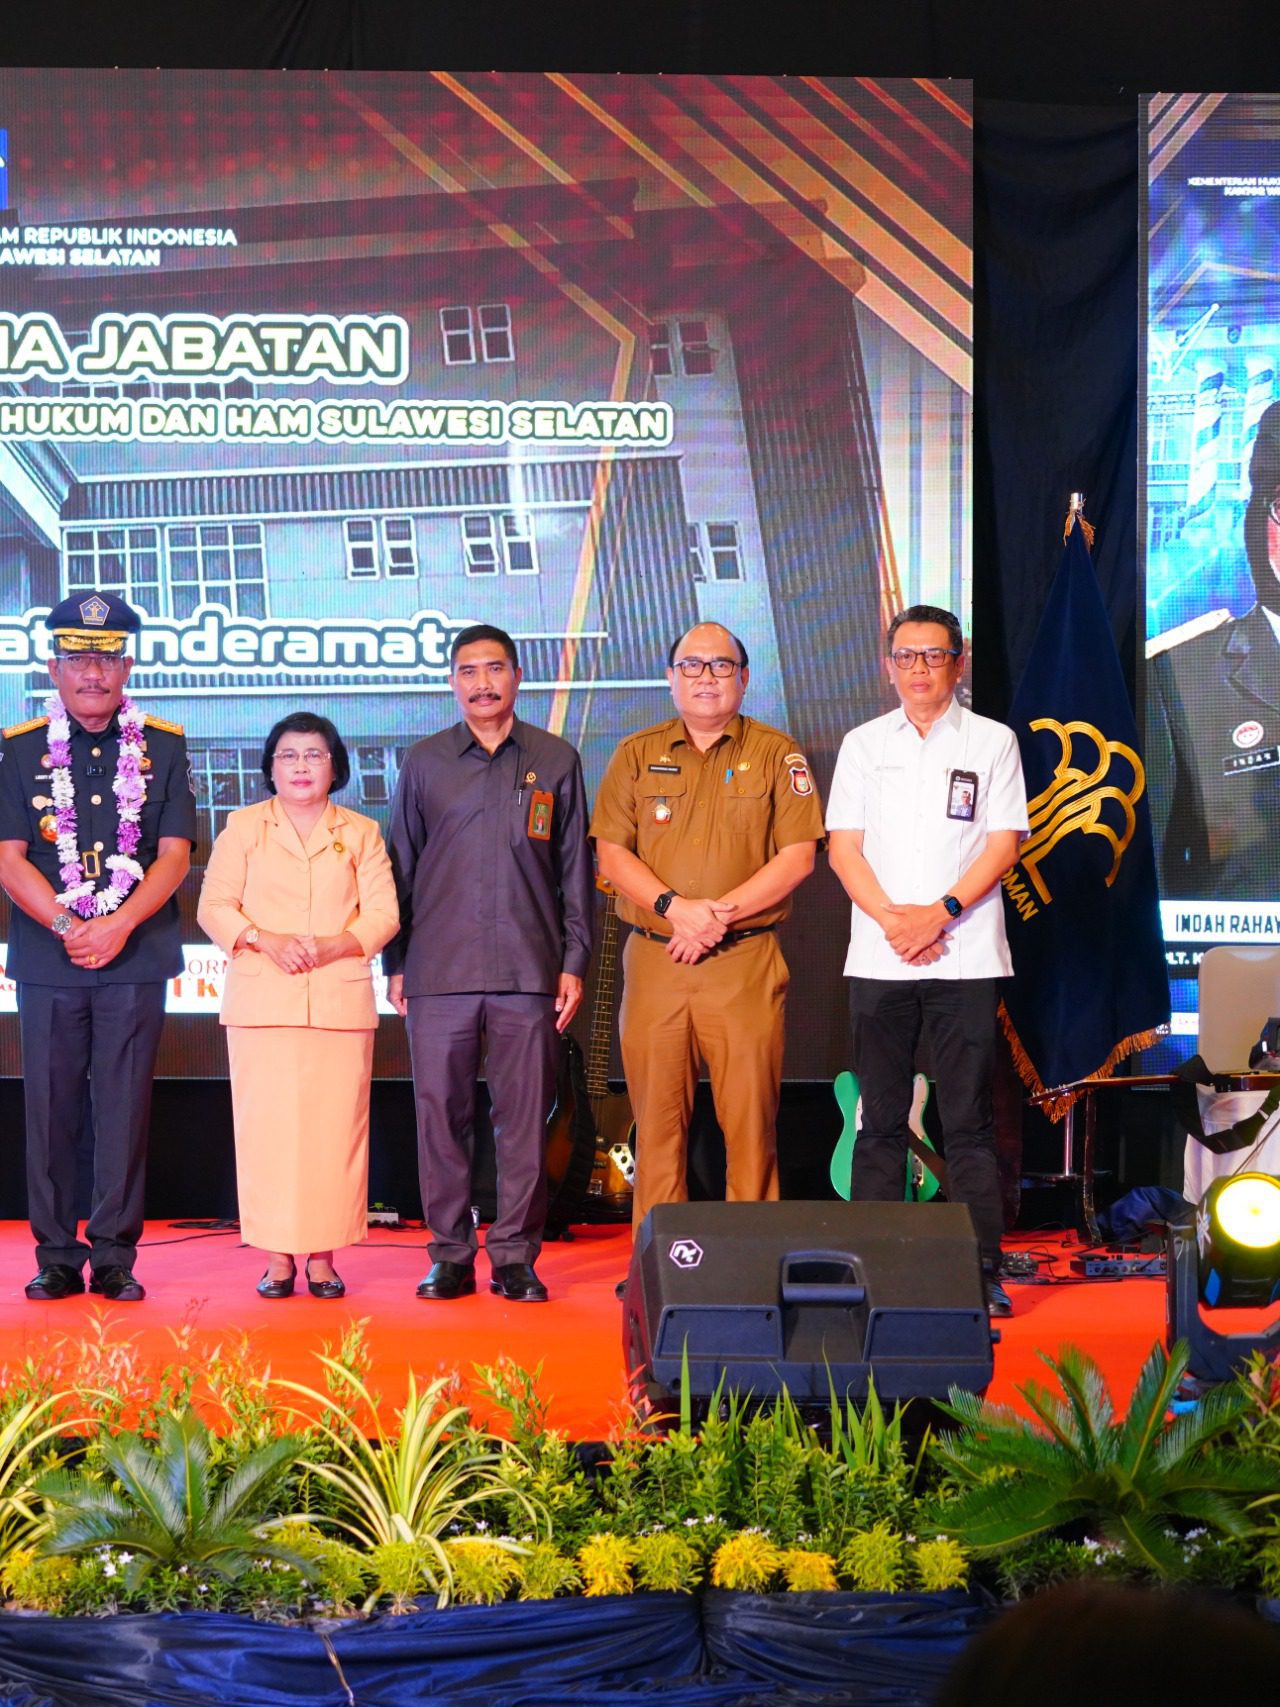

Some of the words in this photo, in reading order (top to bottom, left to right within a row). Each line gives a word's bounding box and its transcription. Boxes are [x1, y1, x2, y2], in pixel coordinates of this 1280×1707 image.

[23, 227, 123, 245] REPUBLIK
[126, 227, 239, 247] INDONESIA
[69, 248, 161, 267] SELATAN
[79, 323, 399, 374] JABATAN
[0, 404, 132, 436] HUKUM
[141, 404, 217, 436] DAN
[226, 405, 310, 437] HAM
[319, 405, 501, 438] SULAWESI
[509, 406, 667, 439] SELATAN
